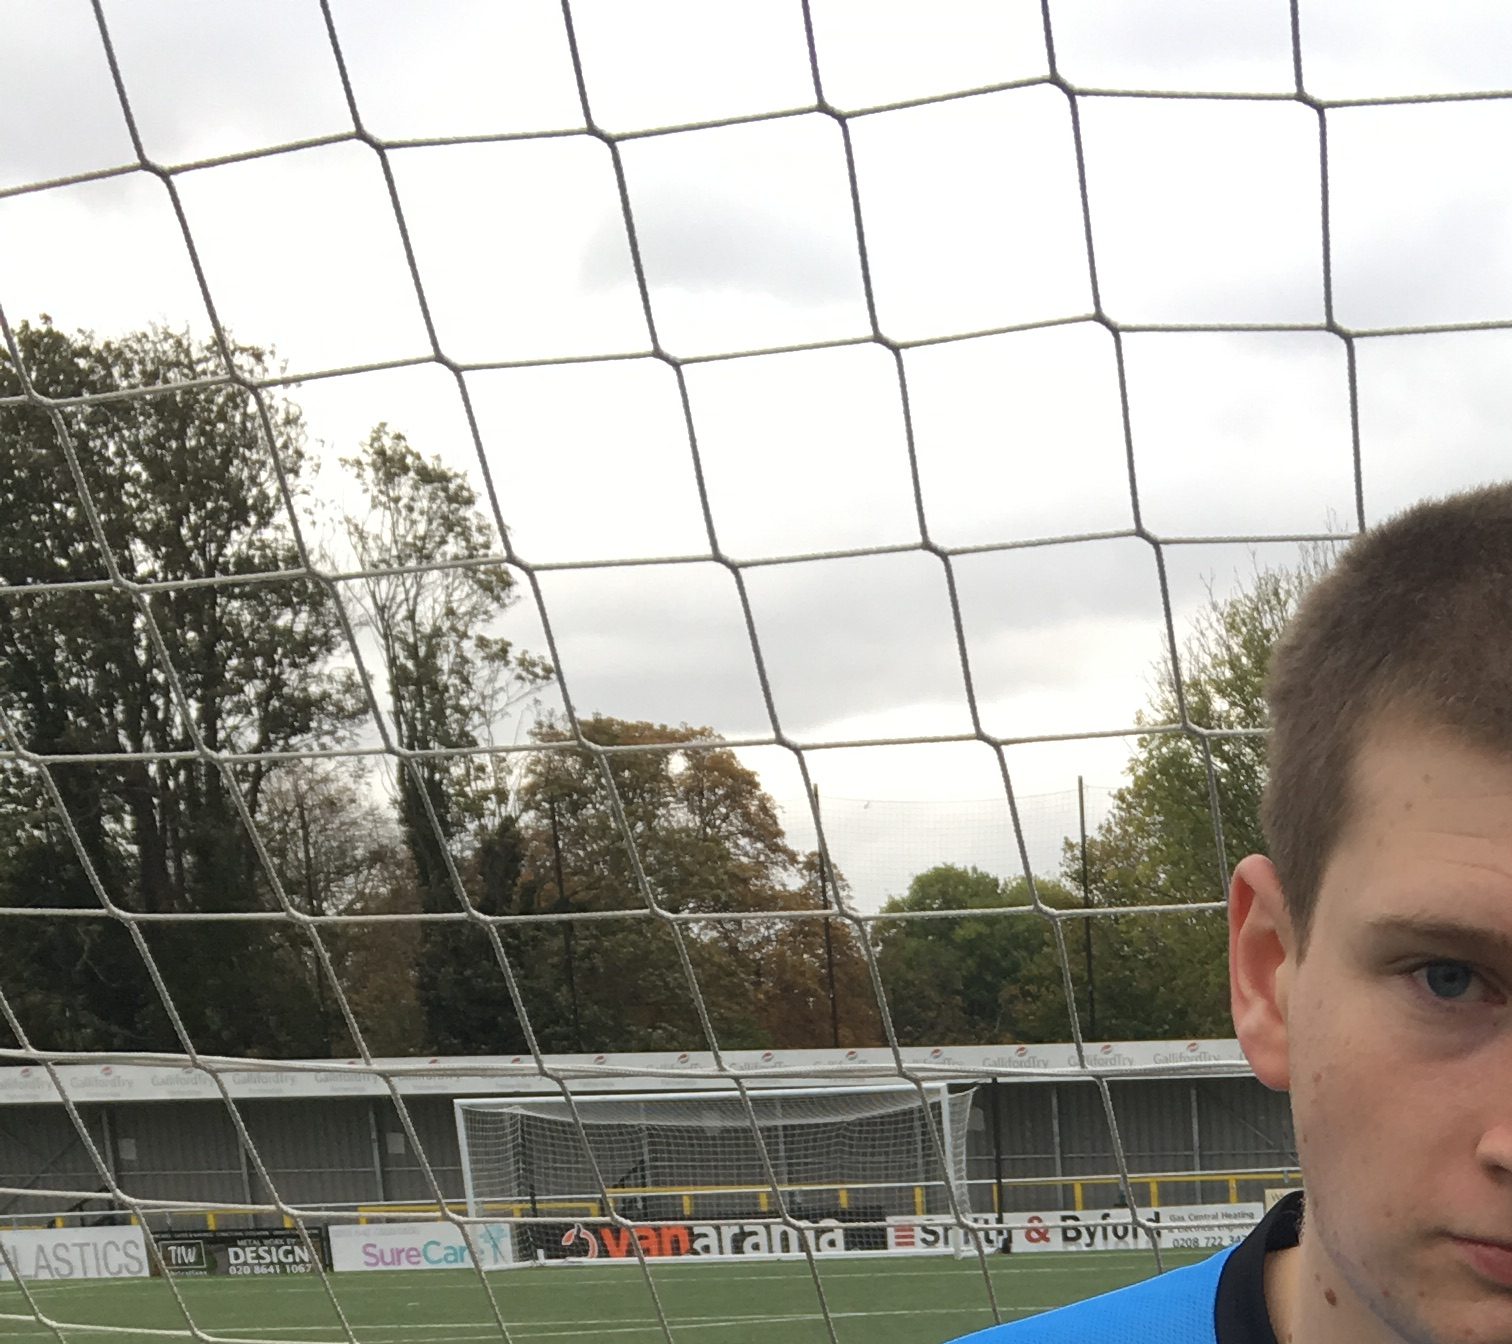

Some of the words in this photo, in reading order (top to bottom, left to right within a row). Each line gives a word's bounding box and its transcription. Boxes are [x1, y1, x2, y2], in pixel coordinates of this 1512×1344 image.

[1067, 1054, 1134, 1067] GllifordTry
[1188, 1211, 1218, 1221] Central
[1221, 1210, 1255, 1220] Heating
[601, 1217, 844, 1258] vanarama
[1024, 1216, 1050, 1244] &
[1060, 1211, 1160, 1248] Byford
[0, 1239, 144, 1279] LASTICS
[228, 1245, 310, 1264] DESIGN
[229, 1266, 250, 1275] 020
